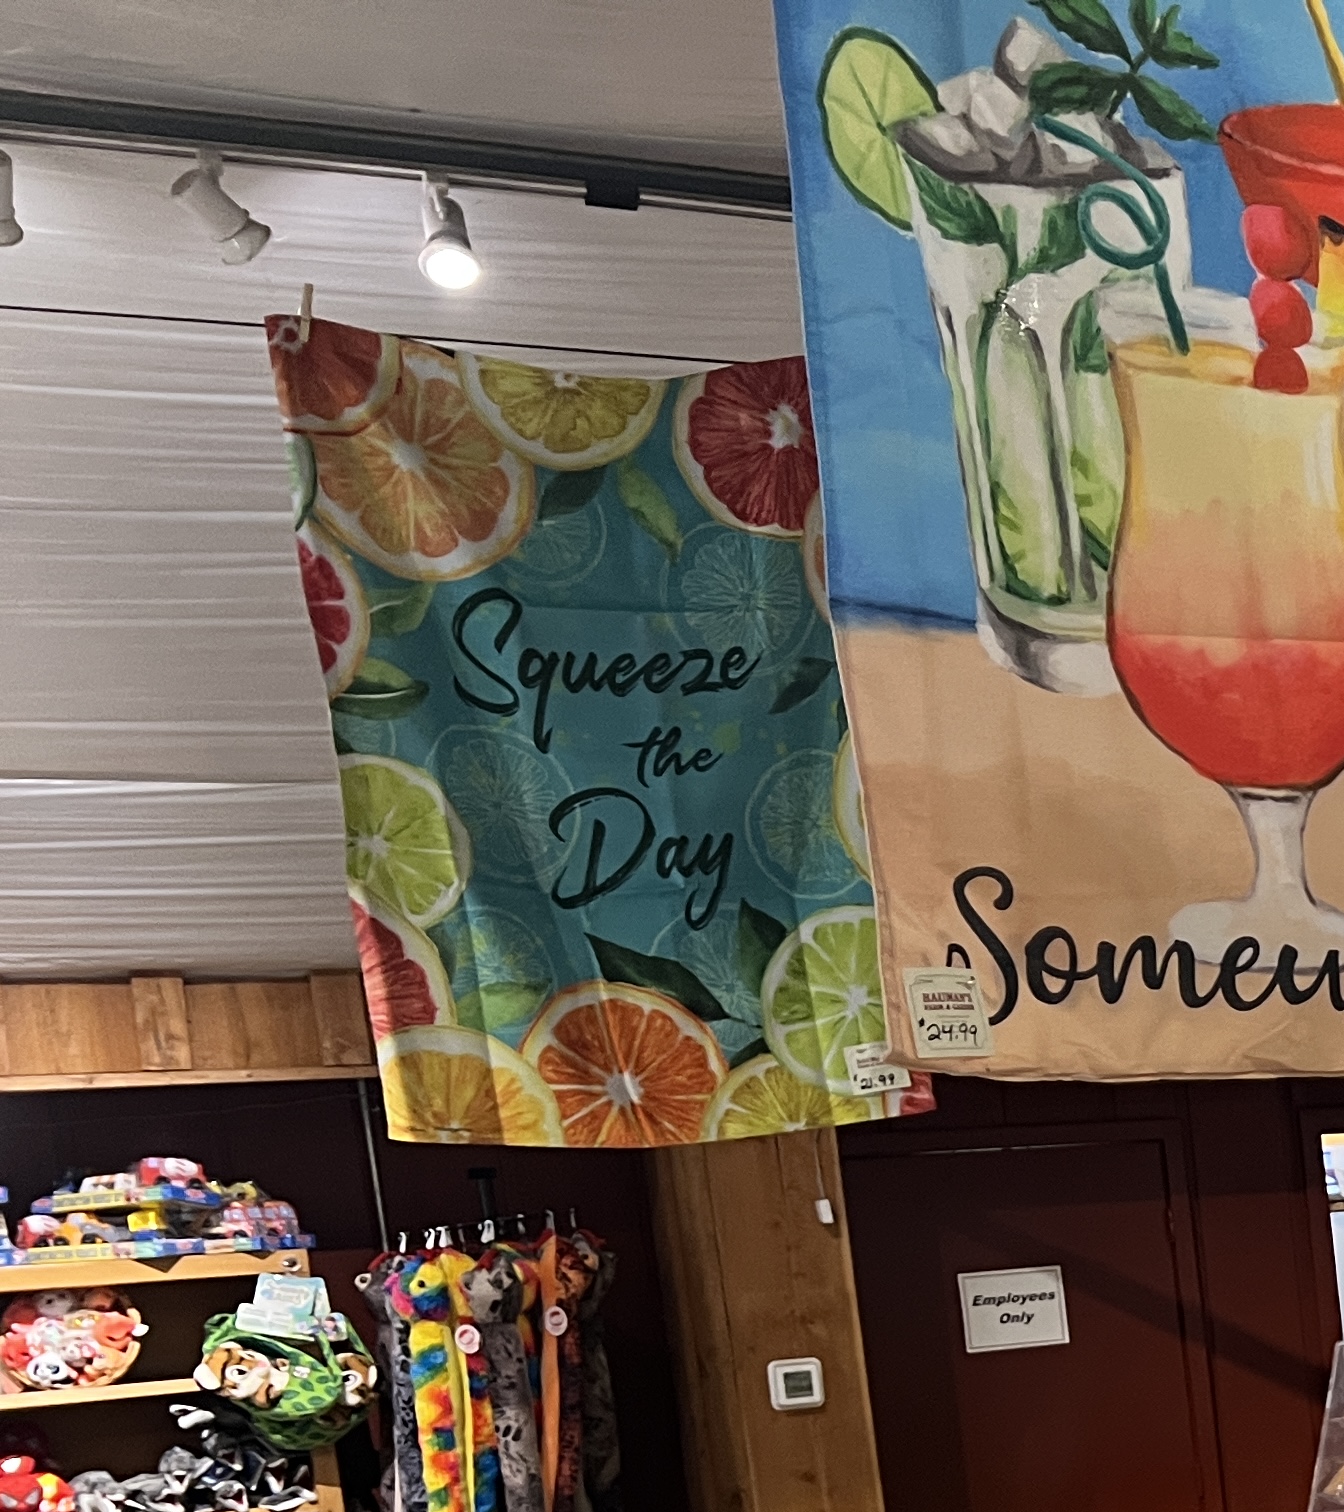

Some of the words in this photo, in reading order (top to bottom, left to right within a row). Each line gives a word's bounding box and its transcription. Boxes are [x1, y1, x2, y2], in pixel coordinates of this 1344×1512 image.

[452, 587, 764, 755] Squeeze
[621, 726, 726, 788] the
[548, 787, 735, 931] Day
[972, 1290, 1056, 1307] Employees
[1000, 1311, 1035, 1325] Only
